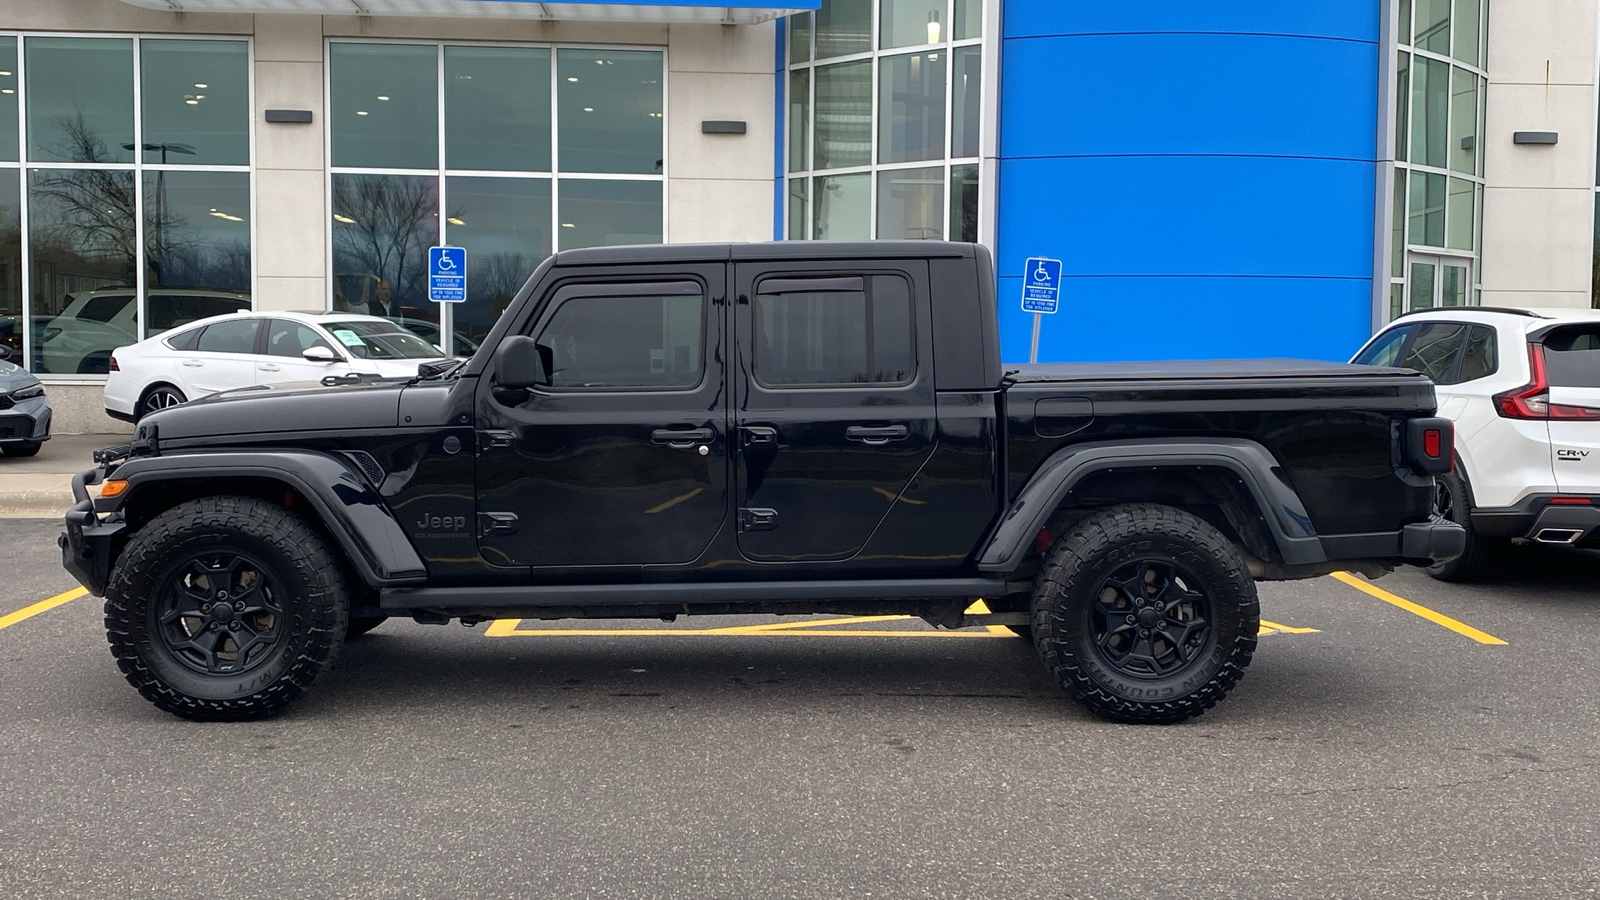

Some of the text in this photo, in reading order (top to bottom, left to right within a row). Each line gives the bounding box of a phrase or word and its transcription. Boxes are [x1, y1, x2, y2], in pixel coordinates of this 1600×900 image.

[1557, 449, 1590, 457] CR-V
[416, 512, 466, 531] Jeep
[1082, 643, 1225, 697] OPEN COUNTRY
